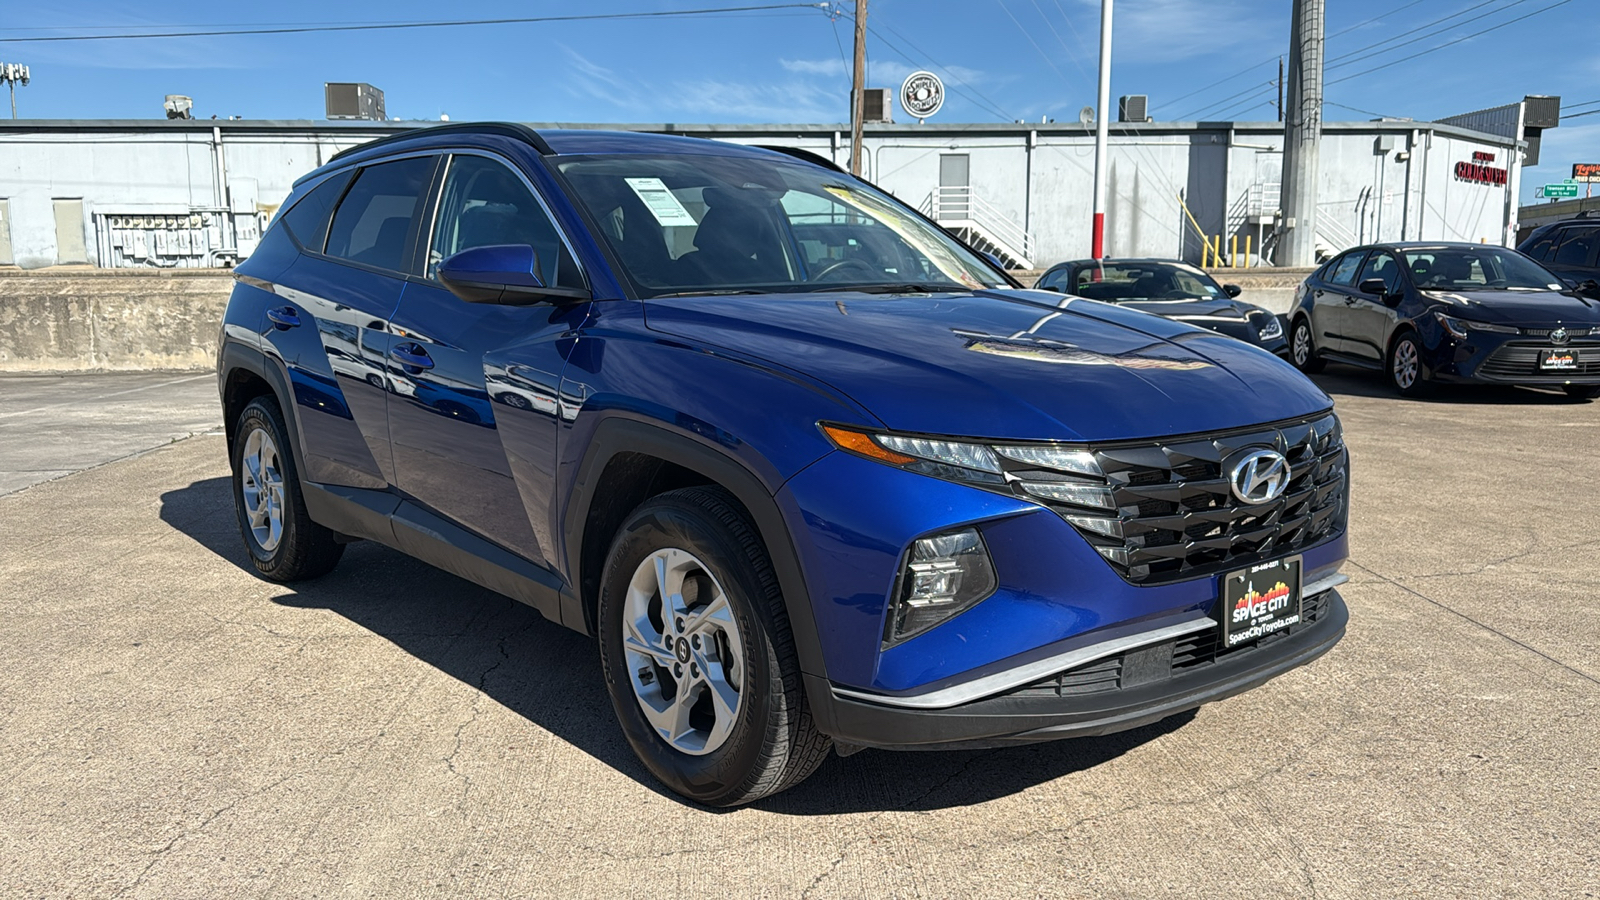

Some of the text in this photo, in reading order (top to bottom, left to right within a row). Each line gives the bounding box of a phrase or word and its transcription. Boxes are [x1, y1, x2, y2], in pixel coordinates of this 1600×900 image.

[1232, 593, 1290, 623] SPACE CITY
[1257, 613, 1274, 623] TOYOTA
[1229, 614, 1299, 645] SpaceCityToyota.com
